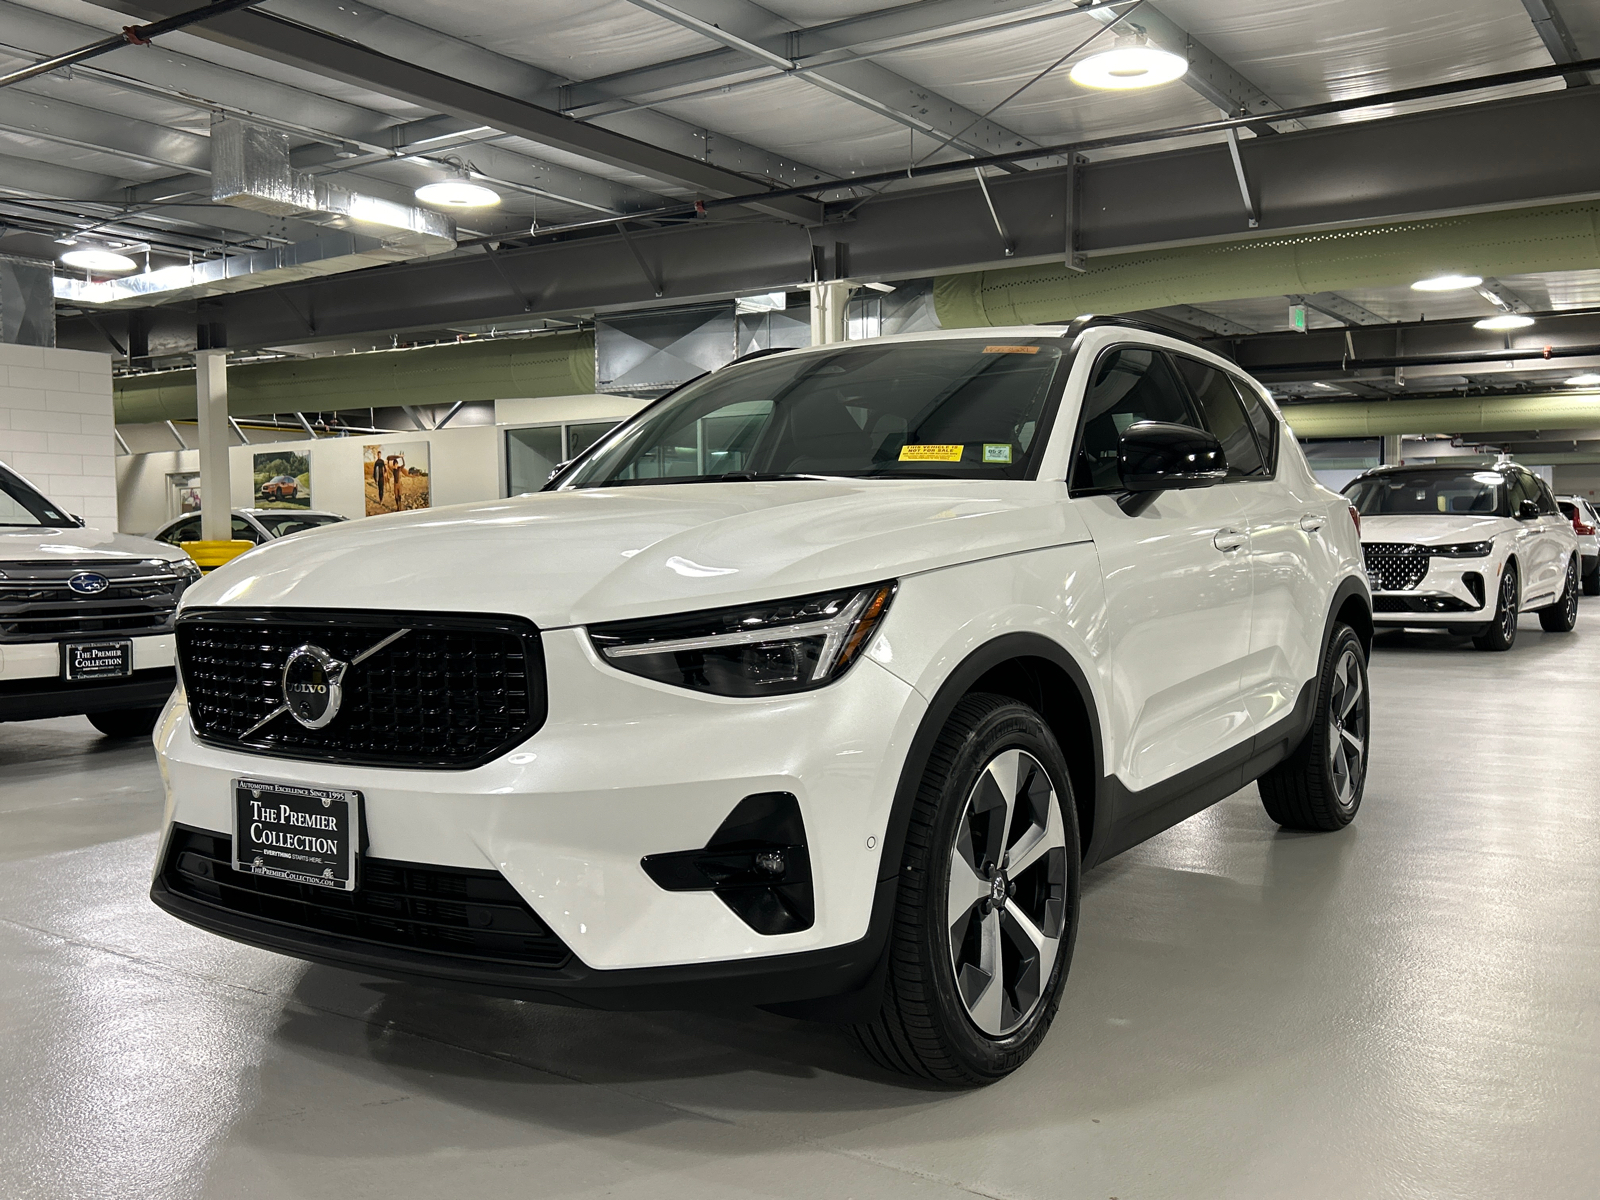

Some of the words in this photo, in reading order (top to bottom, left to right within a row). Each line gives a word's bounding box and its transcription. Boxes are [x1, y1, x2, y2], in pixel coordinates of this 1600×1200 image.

[75, 650, 91, 659] THE
[92, 649, 122, 658] PREMIER
[75, 657, 122, 667] COLLECTION
[287, 682, 327, 694] VOLVO
[239, 781, 274, 791] AUTOMOTIVE
[275, 784, 309, 796] EXCELLENCE
[310, 788, 328, 798] SINCE
[328, 791, 345, 801] 1995
[250, 800, 277, 823] THE
[279, 804, 338, 832] PREMIER
[250, 822, 338, 855] COLLECTION
[263, 848, 292, 859] EVERYTHING
[292, 853, 309, 862] STARTS
